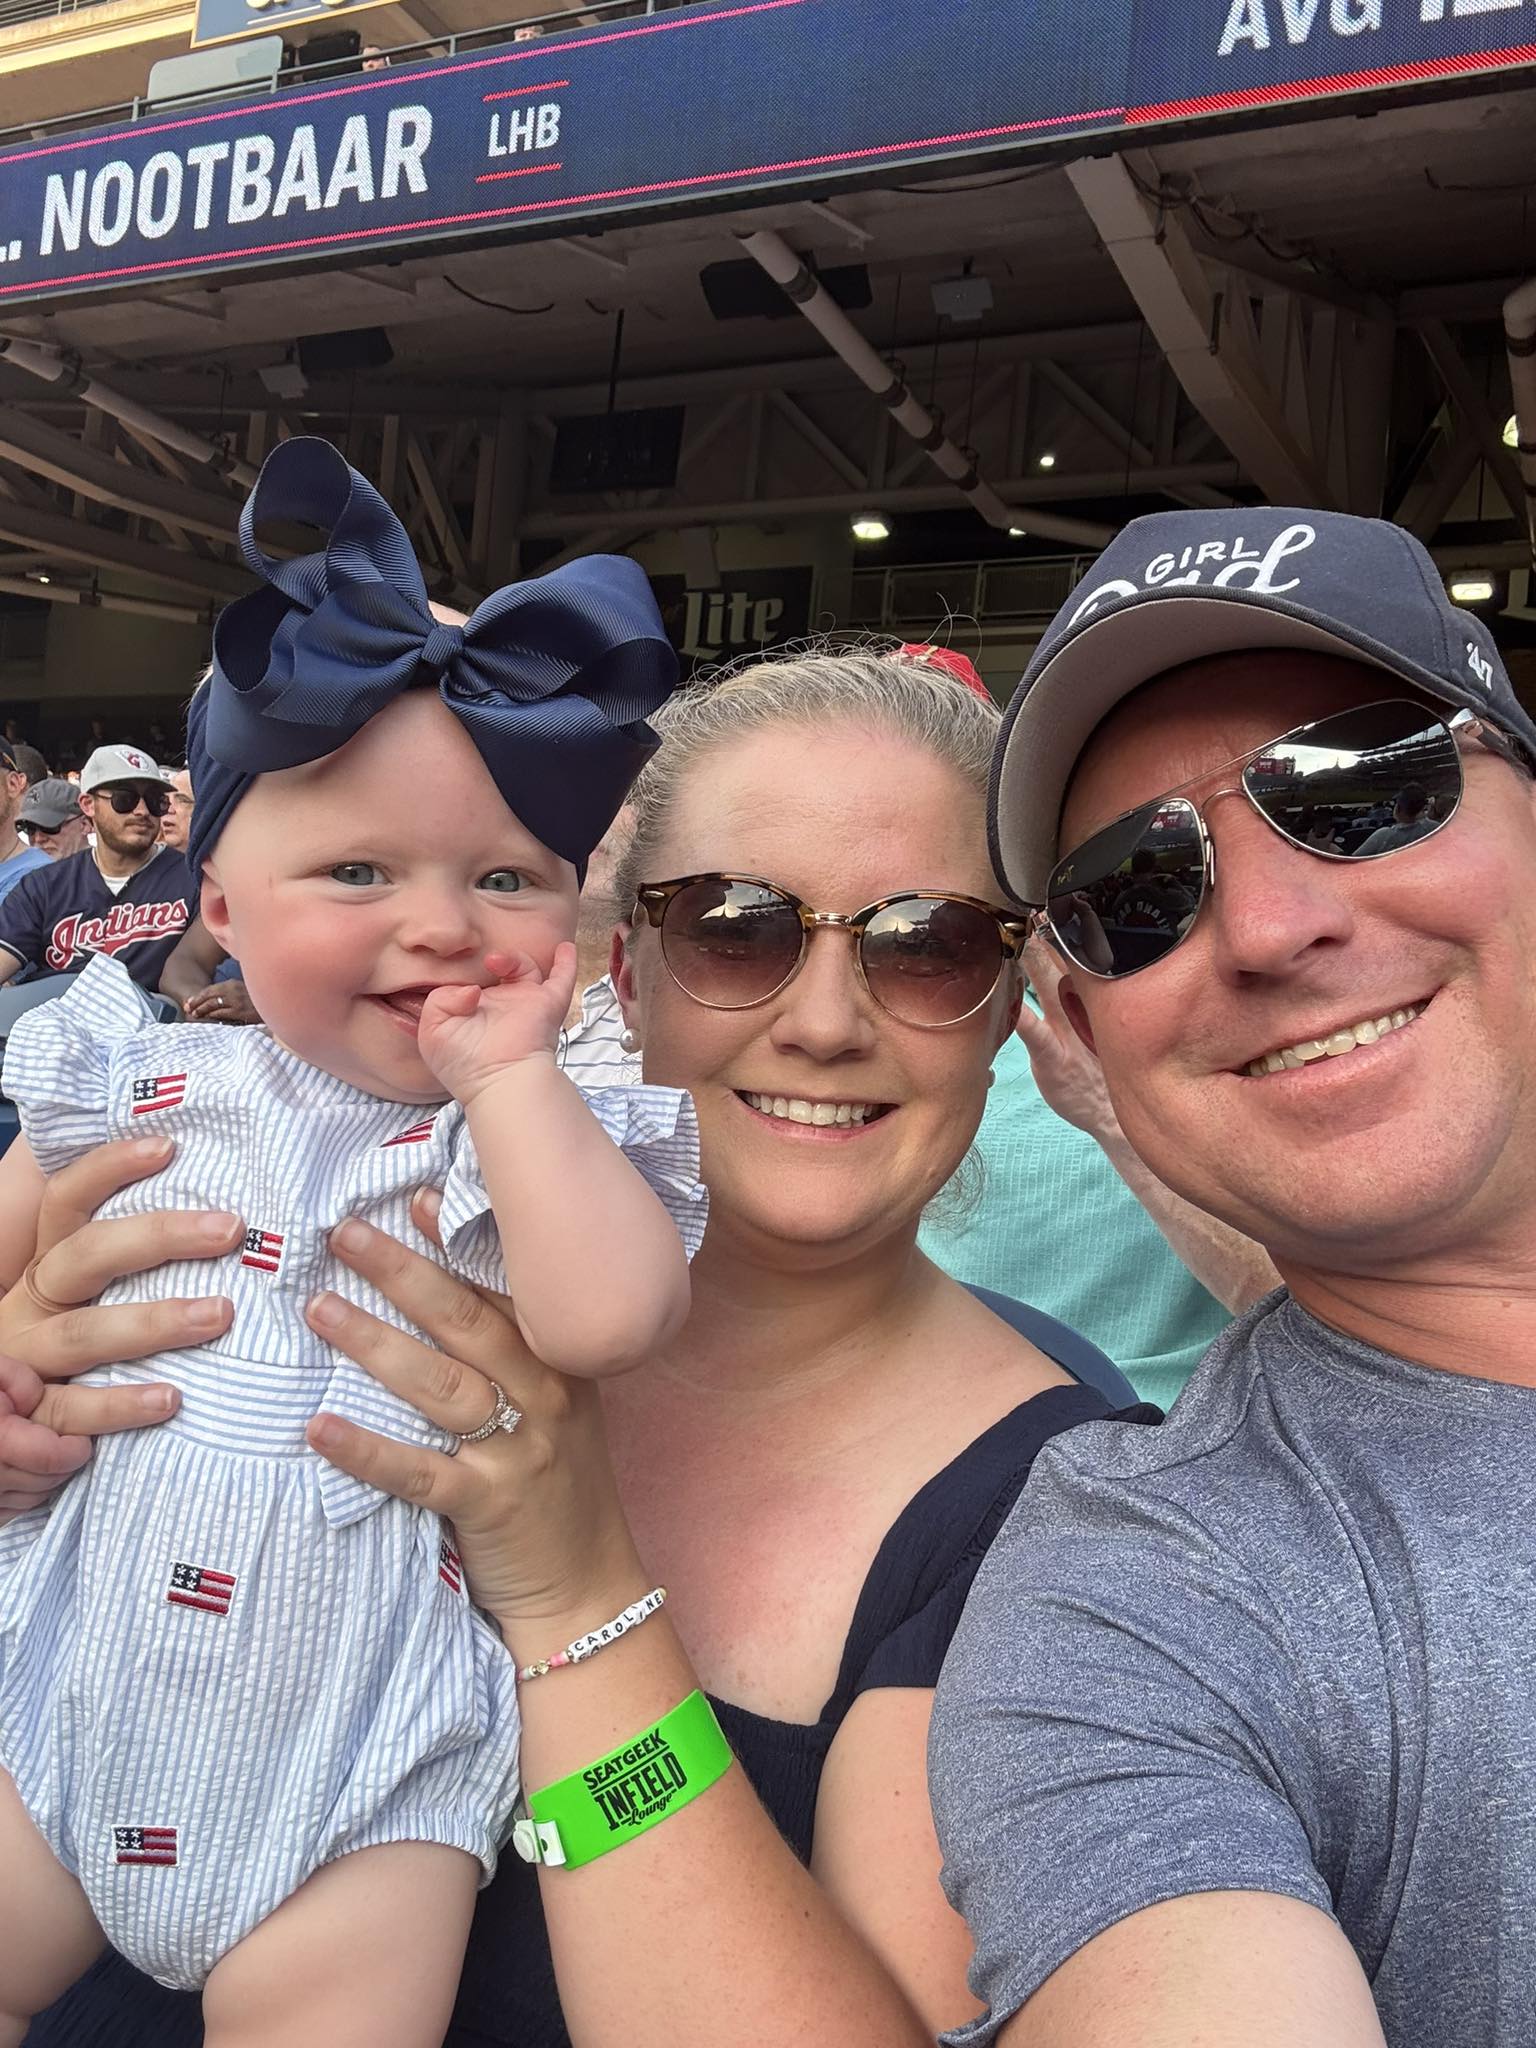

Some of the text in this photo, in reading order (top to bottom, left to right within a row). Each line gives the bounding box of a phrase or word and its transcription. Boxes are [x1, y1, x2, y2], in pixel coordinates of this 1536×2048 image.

[1216, 0, 1383, 56] AVG
[487, 103, 562, 158] LHB
[39, 104, 433, 257] NOOTBAAR
[1145, 536, 1260, 584] GIRL
[679, 591, 783, 660] Lite
[46, 898, 189, 970] Indians
[574, 1592, 662, 1652] CAROLINE
[582, 1727, 668, 1791] SEATGEEK
[593, 1751, 688, 1832] INFIELD
[628, 1793, 673, 1826] Lounge
